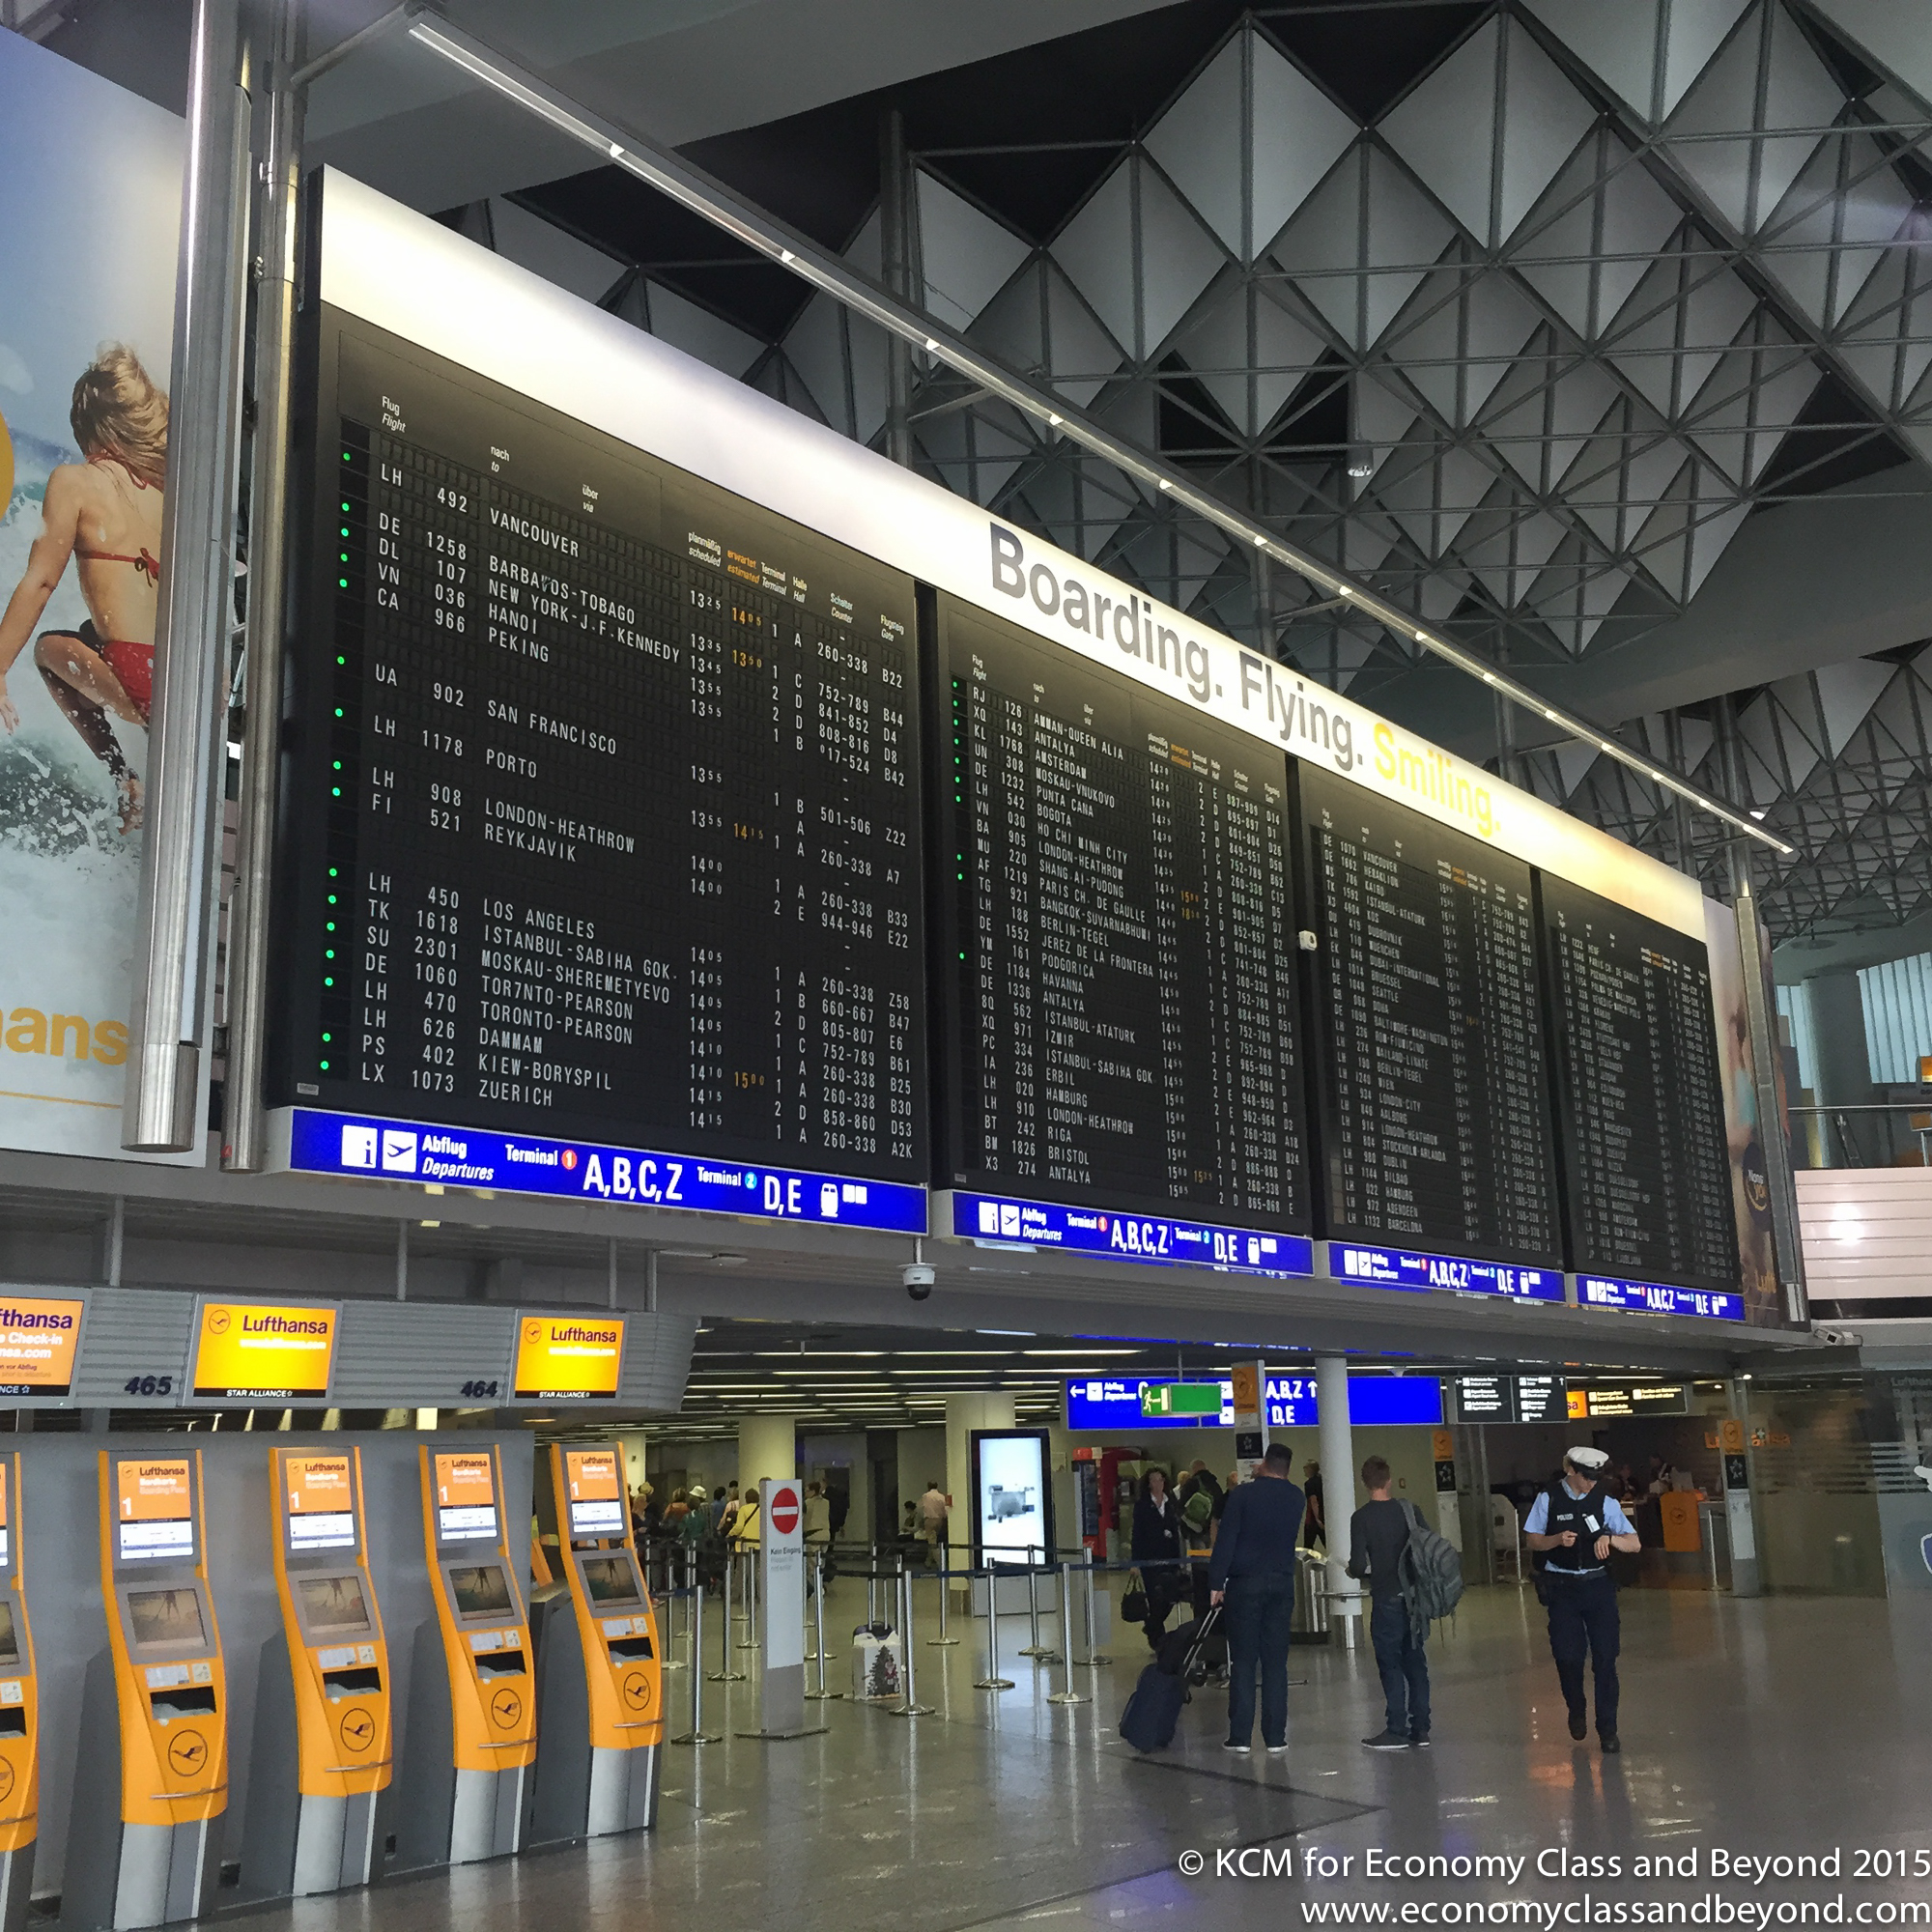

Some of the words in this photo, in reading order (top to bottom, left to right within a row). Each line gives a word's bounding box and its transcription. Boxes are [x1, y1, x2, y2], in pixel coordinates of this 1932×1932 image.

[383, 396, 399, 416] Flug
[383, 413, 406, 432] Flight
[491, 446, 509, 461] nach
[492, 462, 499, 471] to
[582, 485, 598, 499] über
[583, 501, 593, 512] via
[689, 548, 721, 566] scheduled
[727, 551, 756, 567] erwartet
[380, 538, 398, 559] DL
[439, 560, 465, 583] 107
[490, 579, 519, 604] NEW
[382, 464, 401, 486] LH
[438, 488, 467, 512] 492
[491, 508, 578, 556] VANCOUVER
[773, 624, 776, 637] 1
[795, 634, 801, 647] A
[818, 642, 867, 673] 260-338
[883, 668, 901, 688] B22
[727, 565, 759, 583] estimated
[761, 562, 785, 581] Terminal
[763, 577, 786, 595] Terminal
[379, 562, 399, 584] VN
[436, 584, 465, 608] 036
[490, 603, 536, 634] HANOI
[379, 588, 398, 610] CA
[436, 609, 465, 632] 966
[490, 627, 548, 662] PEKING
[380, 513, 399, 535] DE
[428, 532, 466, 559] 1258
[884, 708, 902, 726] B44
[989, 522, 1223, 704] Boarding.
[1239, 649, 1363, 772] Flying.
[1374, 723, 1501, 838] Smiling.
[376, 664, 397, 686] UA
[435, 683, 463, 706] 902
[489, 700, 517, 724] SAN
[530, 714, 615, 753] FRANCISCO
[974, 687, 984, 702] RJ
[1006, 701, 1021, 718] 126
[1035, 714, 1095, 750] AMMAN-QUEEN
[1102, 742, 1122, 759] ALIA
[375, 716, 394, 736] LH
[423, 730, 462, 755] 1178
[487, 749, 536, 778] PORTO
[975, 724, 985, 740] KL
[1001, 735, 1022, 753] 1768
[1036, 750, 1086, 780] AMSTERDAM
[1035, 731, 1074, 758] ANTALYA
[374, 767, 393, 788] LH
[432, 783, 460, 806] 908
[486, 799, 634, 853] LONDON-HEATHROW
[977, 781, 987, 796] LH
[1008, 793, 1024, 810] 542
[1037, 804, 1071, 828] BOGOTA
[373, 794, 390, 813] FI
[431, 809, 459, 831] 521
[486, 823, 575, 862] REYKJAVIK
[370, 872, 390, 893] LH
[429, 887, 458, 908] 450
[484, 899, 513, 921] LOS
[526, 909, 594, 940] ANGELES
[369, 899, 388, 920] TK
[418, 910, 457, 934] 1618
[484, 924, 632, 973] ISTANBUL-SABIHA
[368, 926, 388, 946] SU
[415, 936, 458, 959] 2301
[481, 950, 669, 1004] MOSKAU-SHEREMETYEVO
[366, 952, 386, 973] DE
[416, 963, 456, 985] 1060
[481, 975, 632, 1020] TOR7NTO-PEARSON
[366, 980, 386, 1000] LH
[425, 992, 455, 1012] 470
[480, 1001, 632, 1045] TORONTO-PEARSON
[0, 1007, 128, 1065] ans
[365, 1008, 385, 1028] LH
[424, 1018, 454, 1038] 626
[480, 1028, 542, 1053] DAMMAM
[363, 1035, 384, 1055] PS
[423, 1045, 453, 1065] 402
[479, 1054, 611, 1091] KIEW-BORYSPIL
[1047, 1088, 1087, 1107] HAMBURG
[363, 1063, 384, 1082] LX
[412, 1070, 453, 1092] 1073
[479, 1080, 552, 1106] ZUERICH
[824, 1131, 875, 1152] 260-338
[892, 1142, 912, 1157] A2K
[1049, 1146, 1089, 1164] BRISTOL
[422, 1161, 495, 1181] Departures
[422, 1134, 467, 1159] Abflug
[505, 1144, 558, 1167] Terminal
[583, 1154, 683, 1202] A,B,C,Z
[696, 1166, 741, 1188] Terminal
[764, 1175, 802, 1216] D,E
[1021, 1208, 1047, 1226] Abflug
[1066, 1213, 1096, 1230] Terminal
[1111, 1220, 1168, 1256] A,B,C,Z
[1175, 1227, 1202, 1242] Terminal
[1214, 1233, 1238, 1264] D,E
[1022, 1225, 1063, 1241] Departures
[1497, 1268, 1515, 1294] D,E
[242, 1316, 328, 1336] Lufthansa
[552, 1326, 616, 1343] Lufthansa
[8, 1331, 63, 1346] Check-in
[125, 1376, 173, 1396] 465
[226, 1389, 246, 1398] STAR
[247, 1389, 287, 1398] ALLIANCE
[461, 1381, 497, 1398] 464
[304, 1463, 346, 1472] Lufthansa
[451, 1459, 488, 1468] Lufthansa
[581, 1456, 612, 1465] Lufthansa
[139, 1466, 185, 1477] Lufthansa
[439, 1486, 448, 1502] 1
[571, 1482, 579, 1496] 1
[123, 1497, 131, 1516] 1
[291, 1492, 300, 1509] 1
